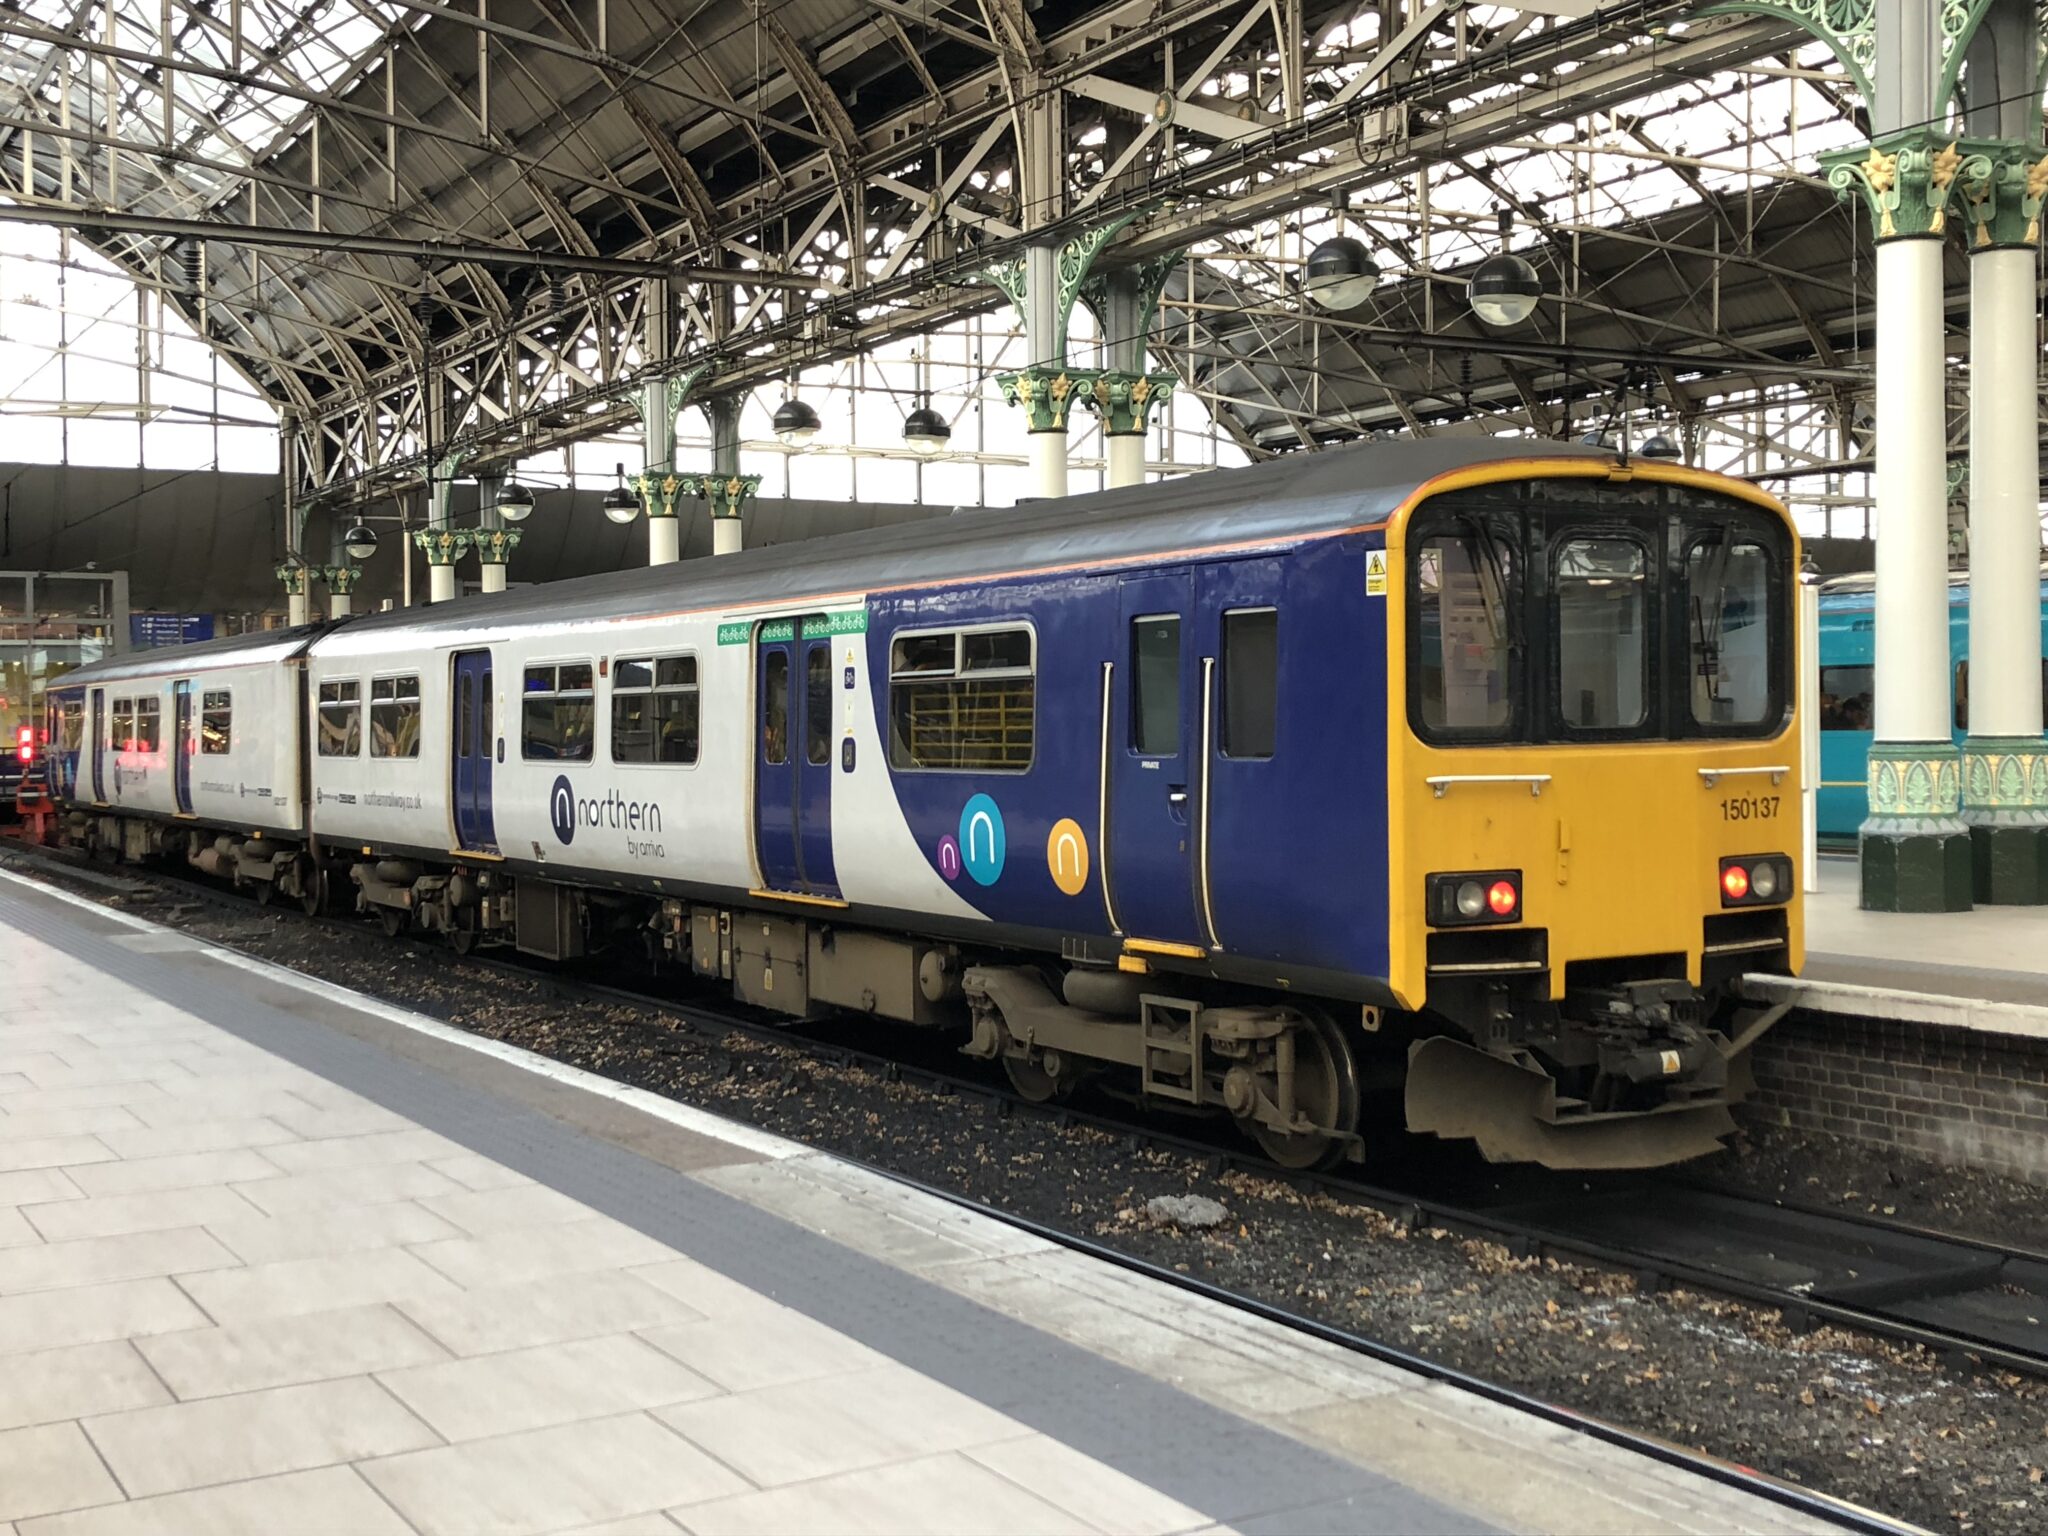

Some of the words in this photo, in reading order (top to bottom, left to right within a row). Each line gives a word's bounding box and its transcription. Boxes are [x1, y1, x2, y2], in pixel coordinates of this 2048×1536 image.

[578, 787, 662, 833] northern
[1720, 796, 1780, 821] 150137
[627, 836, 639, 860] by
[639, 839, 665, 858] arriva
